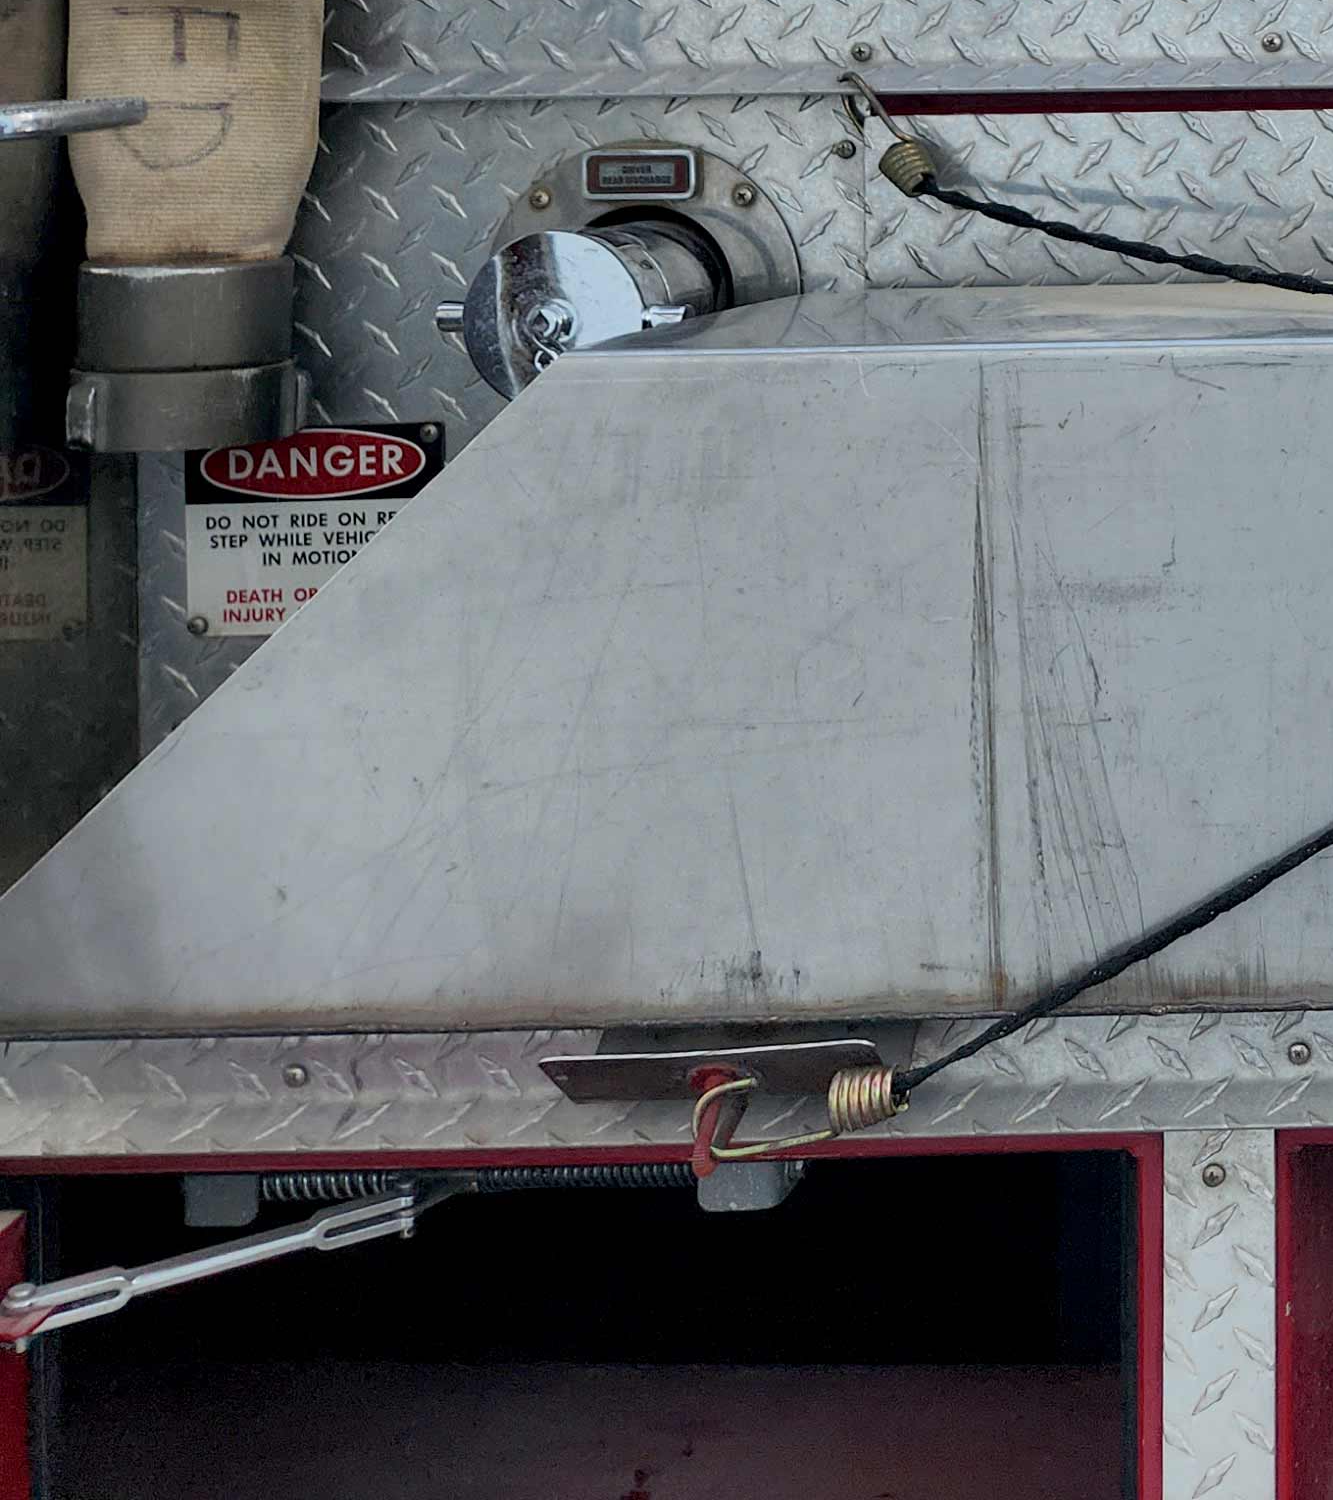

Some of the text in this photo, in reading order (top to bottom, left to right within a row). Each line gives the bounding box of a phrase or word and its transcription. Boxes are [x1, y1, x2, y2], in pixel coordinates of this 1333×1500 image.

[228, 444, 404, 480] DANGER
[206, 516, 231, 530] DO
[242, 515, 280, 528] NOT
[290, 513, 328, 528] RIDE
[338, 512, 366, 526] ON
[210, 535, 248, 549] STEP
[259, 533, 313, 547] WHILE
[263, 552, 281, 566] IN
[226, 589, 282, 604] DEATH
[223, 608, 286, 622] INJURY
